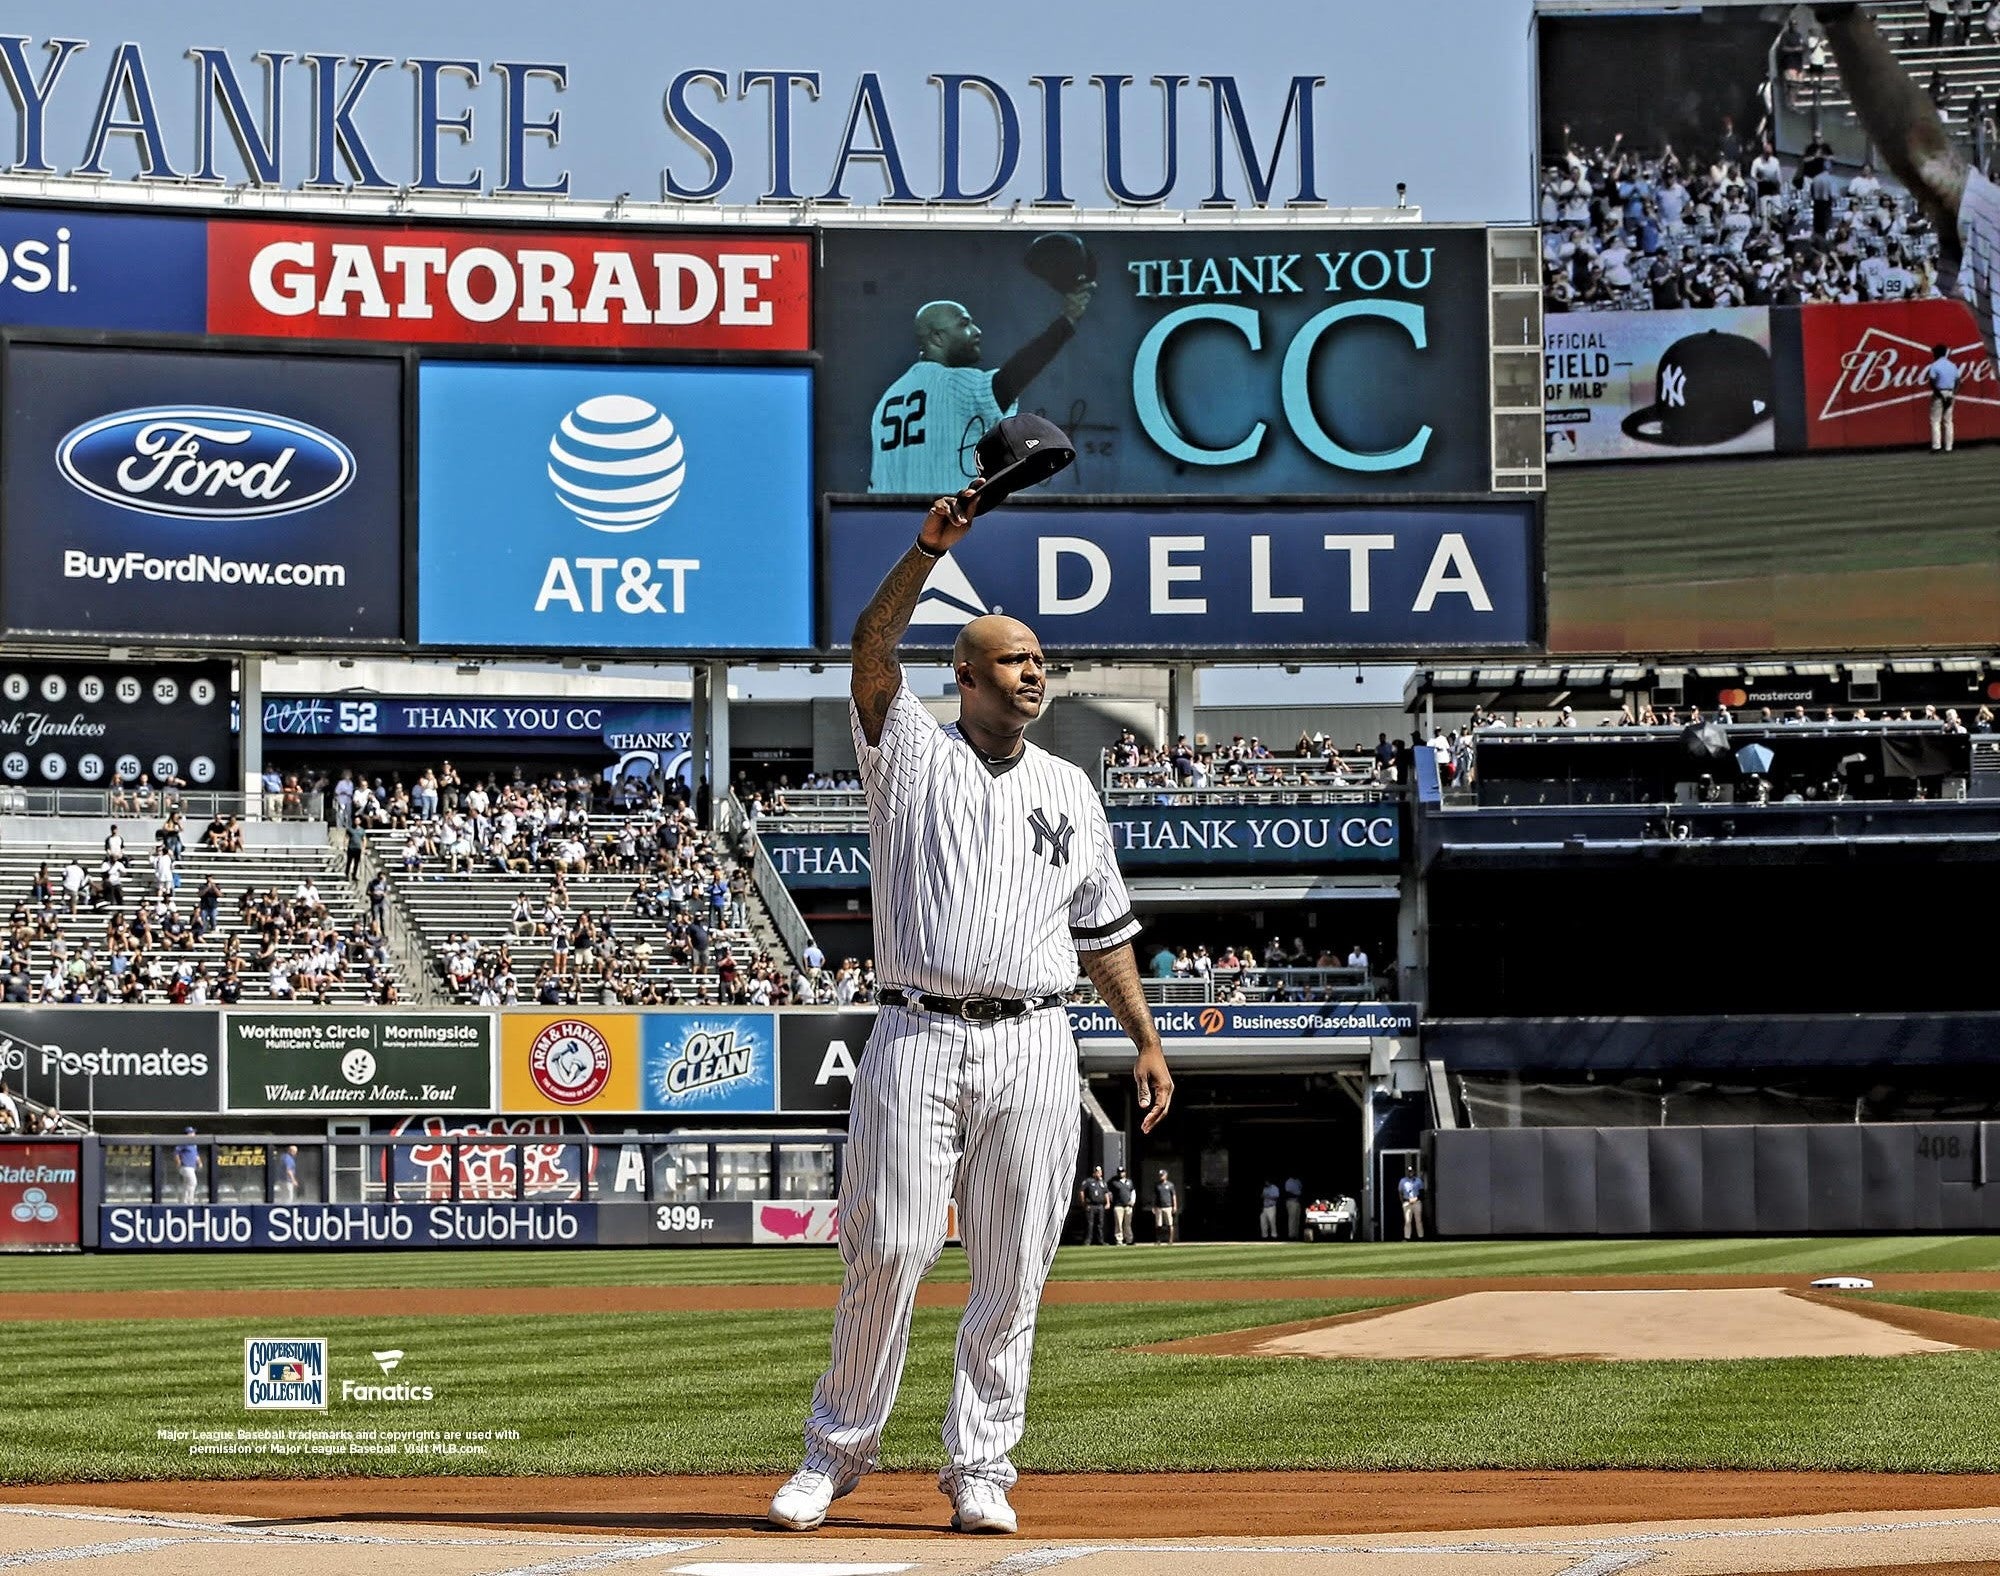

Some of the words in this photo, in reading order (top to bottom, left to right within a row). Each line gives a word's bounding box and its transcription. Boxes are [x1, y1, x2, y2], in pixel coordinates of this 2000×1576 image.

[0, 34, 571, 198] YANKEE
[662, 67, 1329, 209] STADIUM
[0, 227, 70, 293] si
[1128, 254, 1303, 297] THANK
[1316, 247, 1436, 291] YOU
[249, 242, 773, 327] GATORADE
[1543, 333, 1607, 350] FFICIAL
[1545, 352, 1610, 379] FIELD
[1132, 298, 1433, 472] CC
[1570, 382, 1603, 399] MLB
[880, 389, 926, 451] 52
[117, 422, 296, 500] Ford
[64, 550, 346, 588] BuyFordNow.com
[1037, 532, 1495, 617] DELTA
[534, 558, 700, 614] AT&T
[12, 680, 20, 694] 8
[50, 682, 58, 695] 8
[85, 683, 98, 696] 16
[122, 683, 135, 697] 15
[158, 685, 174, 698] 32
[199, 686, 207, 699] 9
[1749, 690, 1813, 701] mastercard
[25, 712, 106, 746] Yankees
[339, 702, 378, 733] 52
[402, 707, 498, 729] THANK
[503, 708, 560, 730] YOU
[566, 709, 602, 730] CC
[610, 732, 675, 750] THANK
[7, 759, 24, 772] 42
[49, 760, 58, 773] 6
[85, 761, 98, 774] 51
[120, 762, 136, 774] 46
[158, 763, 173, 775] 20
[199, 764, 206, 776] 2
[1027, 807, 1075, 868] NY
[1110, 820, 1238, 850] THANK
[1247, 818, 1330, 849] YOU
[1341, 818, 1394, 848] CC
[773, 847, 871, 874] THAN
[239, 1024, 322, 1039] Workmen's
[326, 1024, 370, 1039] Circle
[385, 1025, 478, 1041] Morningside
[1232, 1013, 1412, 1030] BusinessOfBaseball.com
[41, 1044, 209, 1076] Postmates
[266, 1039, 311, 1050] MultiCare
[313, 1040, 346, 1050] Center
[533, 1035, 553, 1070] ARM
[561, 1023, 607, 1070] HAMMER
[685, 1032, 734, 1064] OXI
[668, 1049, 750, 1093] CLEAN
[265, 1084, 306, 1101] What
[309, 1085, 366, 1102] Matters
[109, 1207, 252, 1244] StubHub
[267, 1206, 413, 1242] StubHub
[428, 1205, 578, 1241] StubHub
